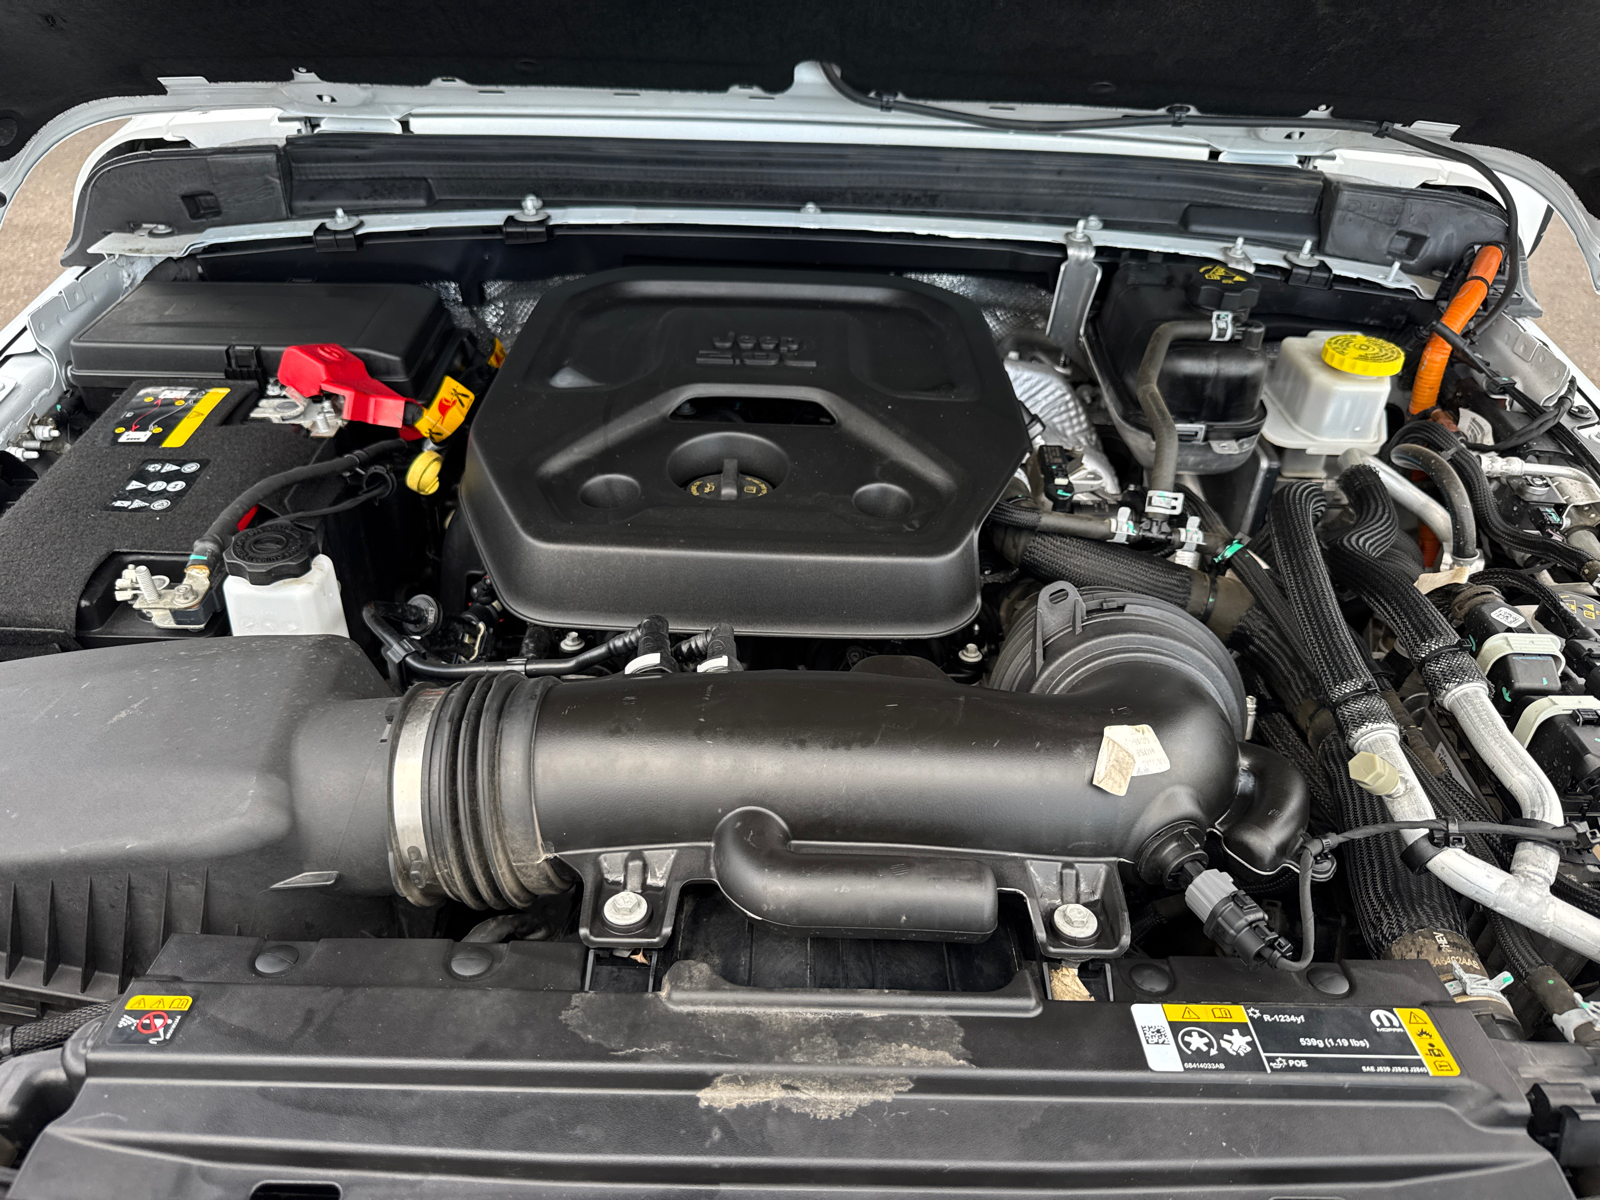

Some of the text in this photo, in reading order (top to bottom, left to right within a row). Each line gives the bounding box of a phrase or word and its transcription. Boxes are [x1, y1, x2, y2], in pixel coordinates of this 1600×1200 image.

[712, 331, 801, 353] Jeep
[1263, 1014, 1305, 1024] R-1234yf
[1299, 1038, 1370, 1049] 539g (1.19 lbs)
[1288, 1059, 1308, 1068] POE
[1361, 1065, 1376, 1073] SAE
